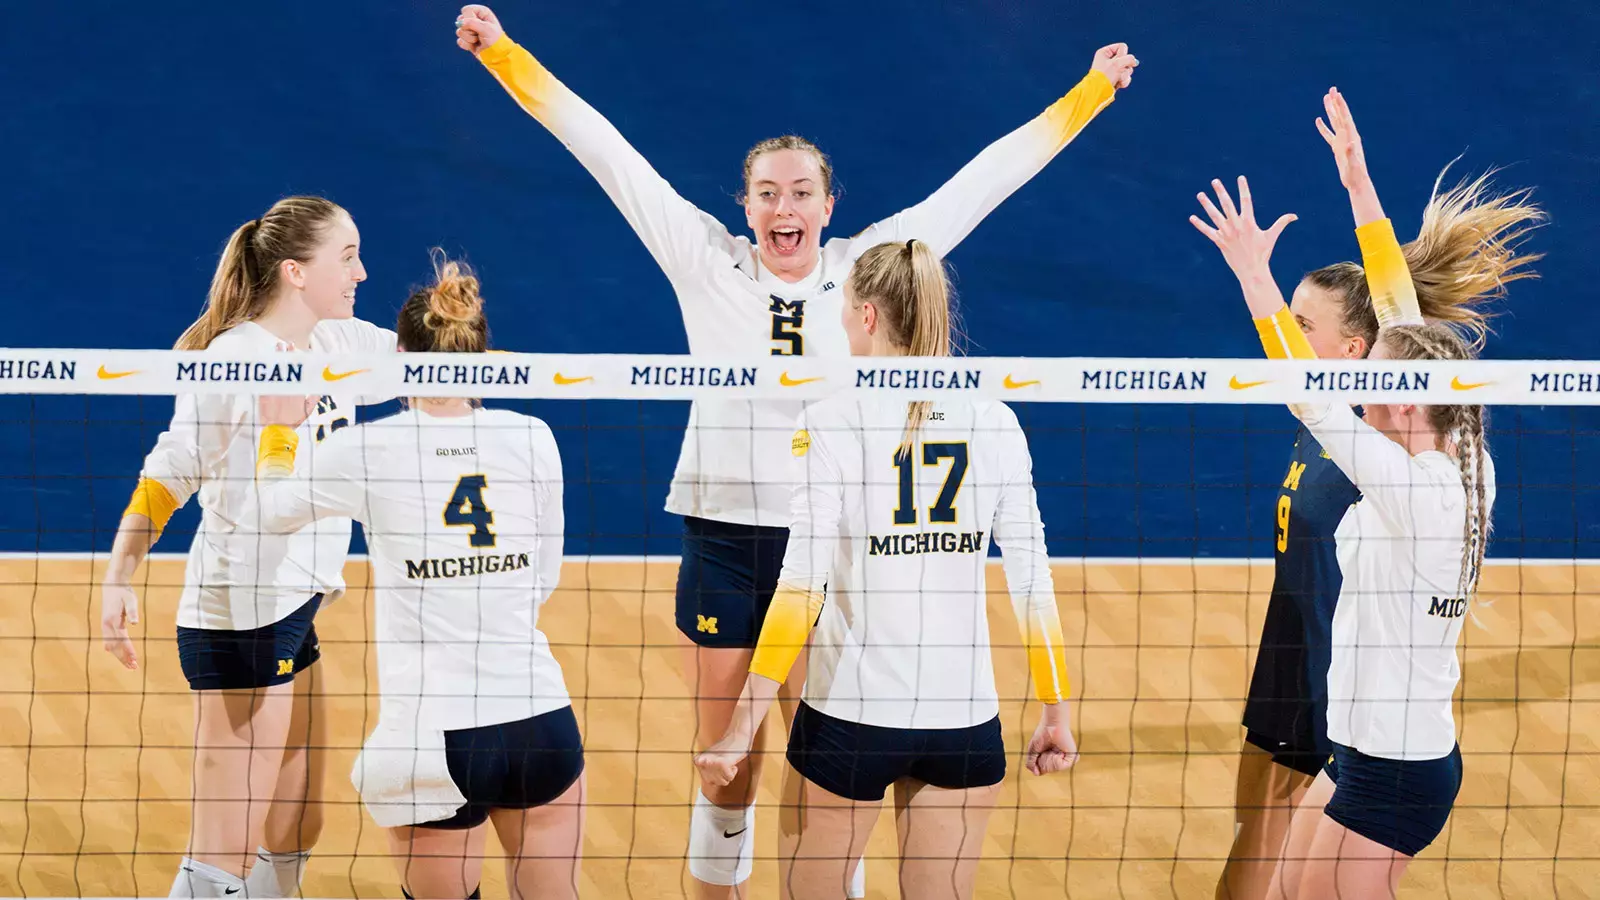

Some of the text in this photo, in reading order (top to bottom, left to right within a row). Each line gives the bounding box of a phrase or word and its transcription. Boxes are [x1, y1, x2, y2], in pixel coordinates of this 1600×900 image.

[769, 293, 806, 317] M
[770, 314, 804, 356] 5
[0, 360, 76, 380] HIGAN
[176, 362, 303, 382] MICHIGAN
[403, 365, 530, 385] MICHIGAN
[631, 367, 757, 387] MICHIGAN
[855, 369, 981, 389] MICHIGAN
[1082, 371, 1207, 390] MICHIGAN
[1305, 372, 1430, 391] MICHIGAN
[436, 446, 477, 456] GO BLUE
[892, 440, 969, 526] 17
[1283, 460, 1306, 491] M
[442, 473, 497, 548] 4
[1277, 494, 1291, 554] 9
[868, 530, 984, 556] MICHIGAN
[405, 552, 531, 580] MICHIGAN
[696, 614, 718, 634] M
